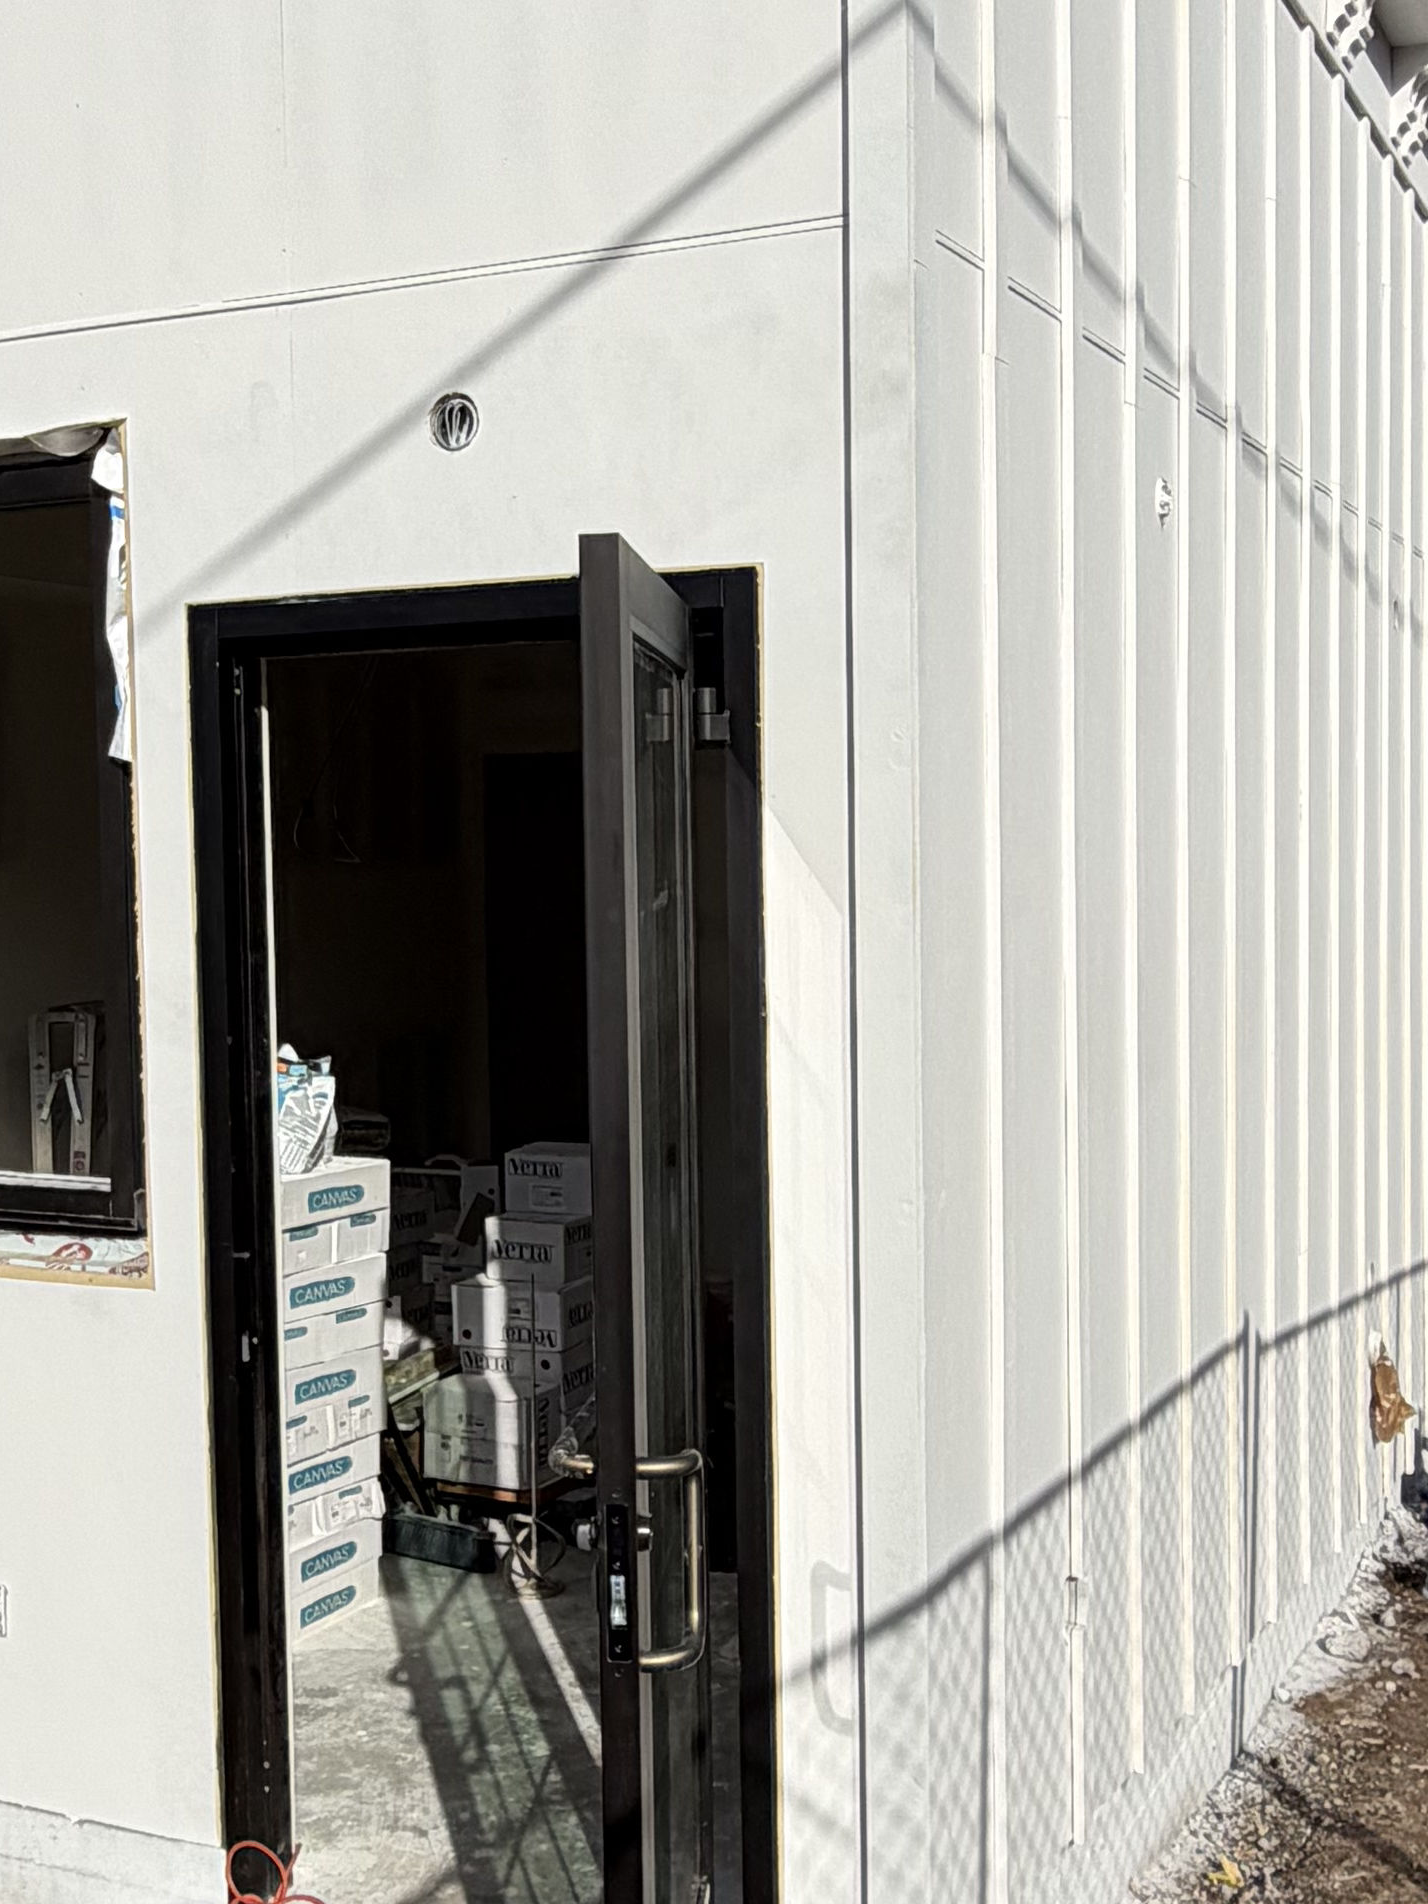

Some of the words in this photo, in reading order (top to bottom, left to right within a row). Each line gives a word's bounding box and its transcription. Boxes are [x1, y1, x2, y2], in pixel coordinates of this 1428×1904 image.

[312, 1188, 357, 1208] CANVAS
[295, 1279, 347, 1303] CANVAS
[299, 1373, 349, 1399] CANVAS
[293, 1460, 344, 1489] CANVAS
[304, 1546, 350, 1576] CANVAS
[303, 1589, 349, 1622] CANVAS
